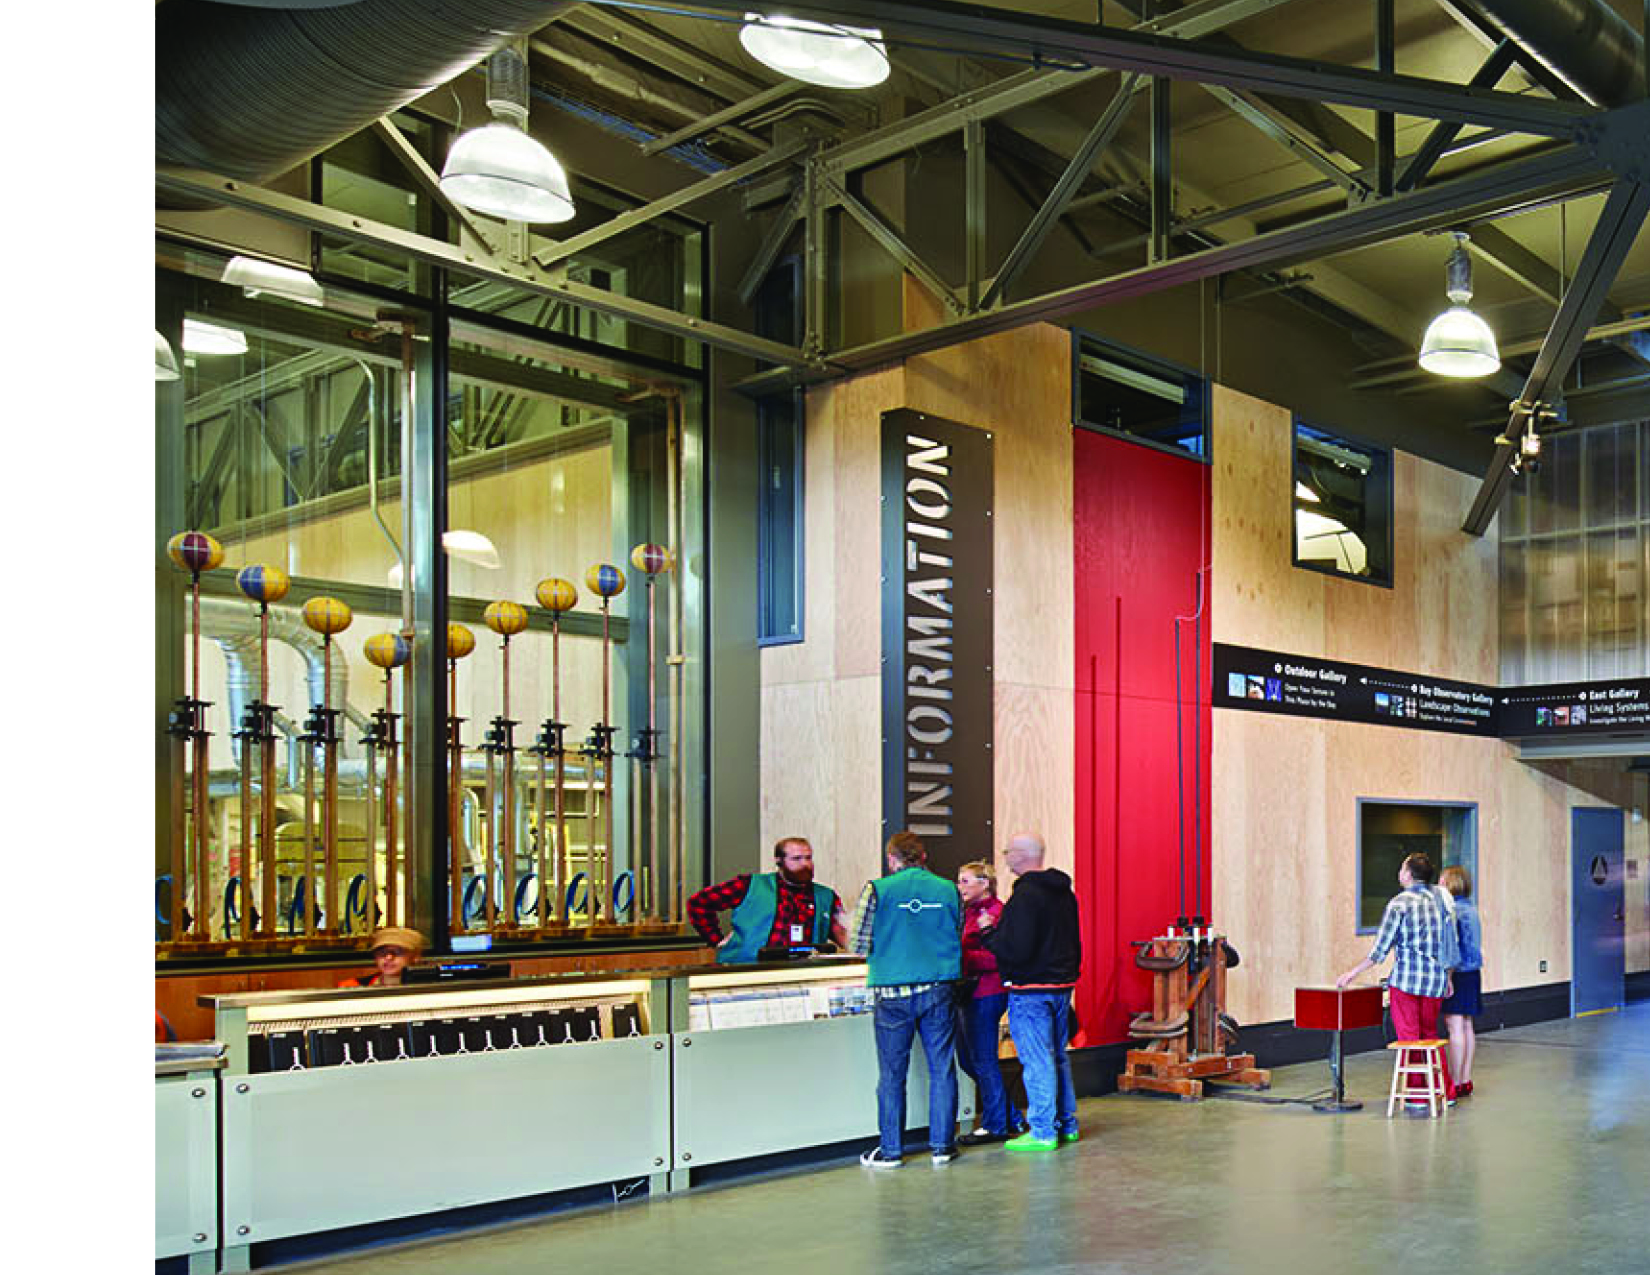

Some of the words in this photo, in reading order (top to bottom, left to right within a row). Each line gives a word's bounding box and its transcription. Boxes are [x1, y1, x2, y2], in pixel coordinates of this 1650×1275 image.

[907, 434, 952, 836] INFORMATION
[1284, 664, 1317, 679] Outdoor
[1319, 668, 1347, 685] Gallery
[1472, 692, 1494, 707] Gallery
[1590, 689, 1607, 700] East
[1608, 687, 1640, 700] Gallery
[1590, 703, 1614, 715] Living
